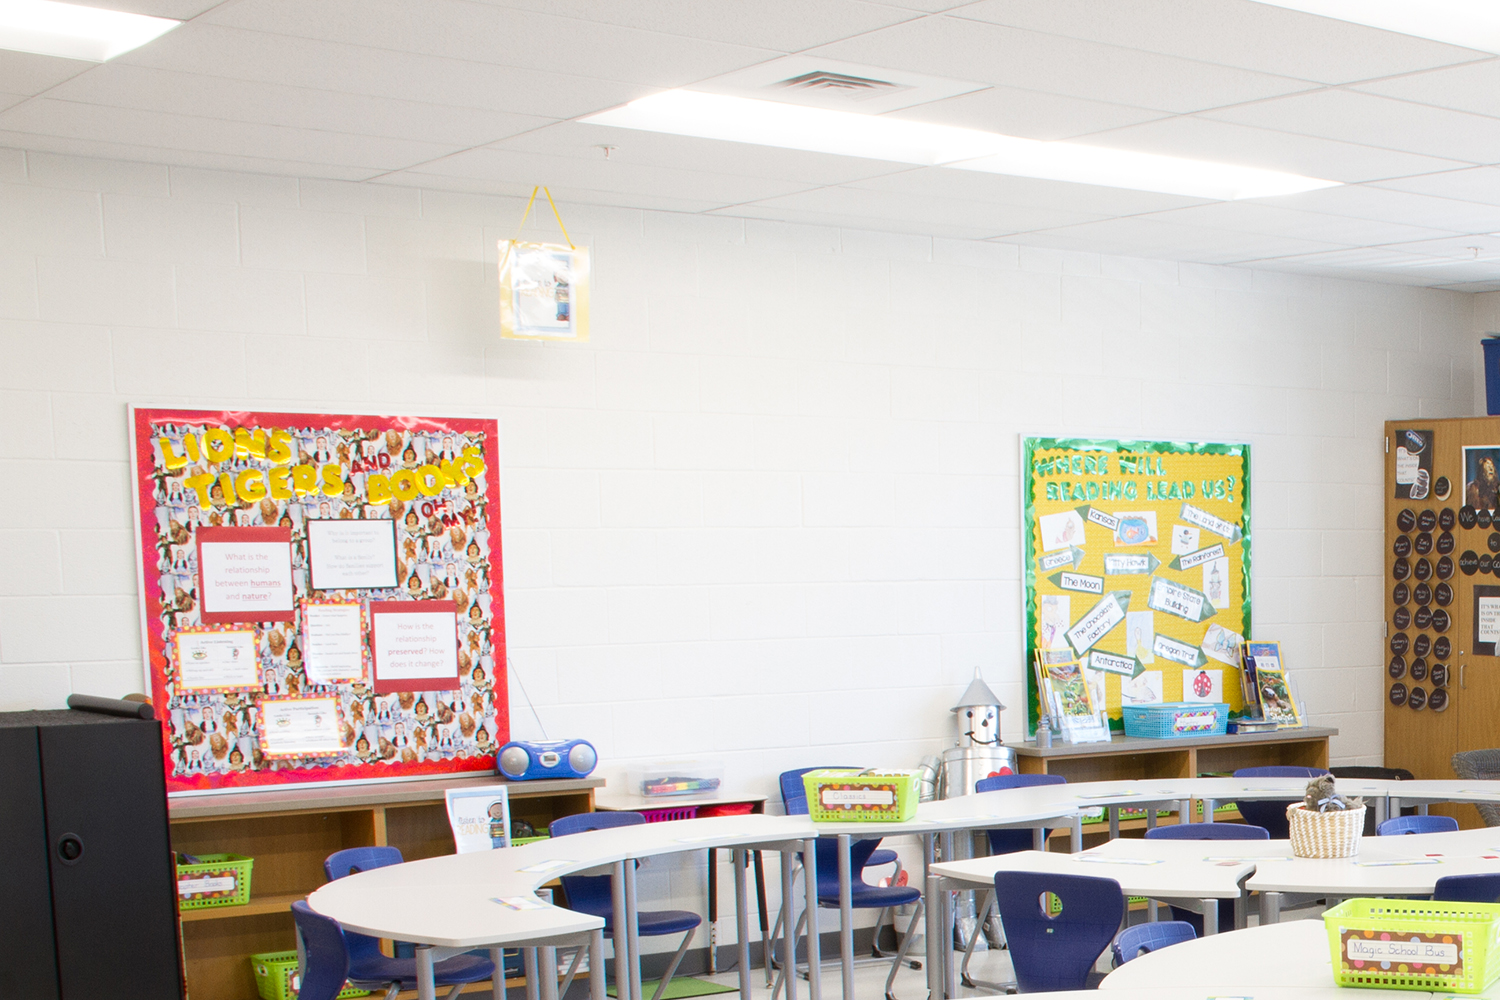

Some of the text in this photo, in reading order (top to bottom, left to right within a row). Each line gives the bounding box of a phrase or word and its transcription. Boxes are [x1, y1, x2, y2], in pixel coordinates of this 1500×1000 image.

[159, 427, 292, 470] LIONS
[350, 453, 391, 475] AND
[1033, 455, 1167, 477] WHERE WILL
[183, 446, 485, 511] TIGERS BOOKS
[1046, 475, 1236, 503] READING LEAD US?
[421, 498, 446, 518] OH
[1089, 510, 1115, 527] Kansas
[1460, 512, 1474, 522] We
[225, 553, 269, 561] What is the
[1181, 547, 1222, 567] The Rainforest
[225, 566, 270, 574] relationship
[214, 579, 281, 588] between humans
[1064, 575, 1101, 590] The Moon
[225, 591, 272, 601] and nature?
[1182, 591, 1201, 606] State
[1164, 597, 1189, 615] Building
[422, 622, 434, 630] the
[1074, 602, 1114, 639] The Chocolate
[1087, 618, 1111, 642] Factory
[395, 635, 437, 643] relationship
[387, 647, 445, 656] preserved? How
[408, 660, 413, 668] it
[415, 659, 444, 668] change?
[1094, 655, 1133, 670] Antarctica
[833, 791, 866, 800] Classics
[1353, 942, 1445, 958] Magic School Bus
